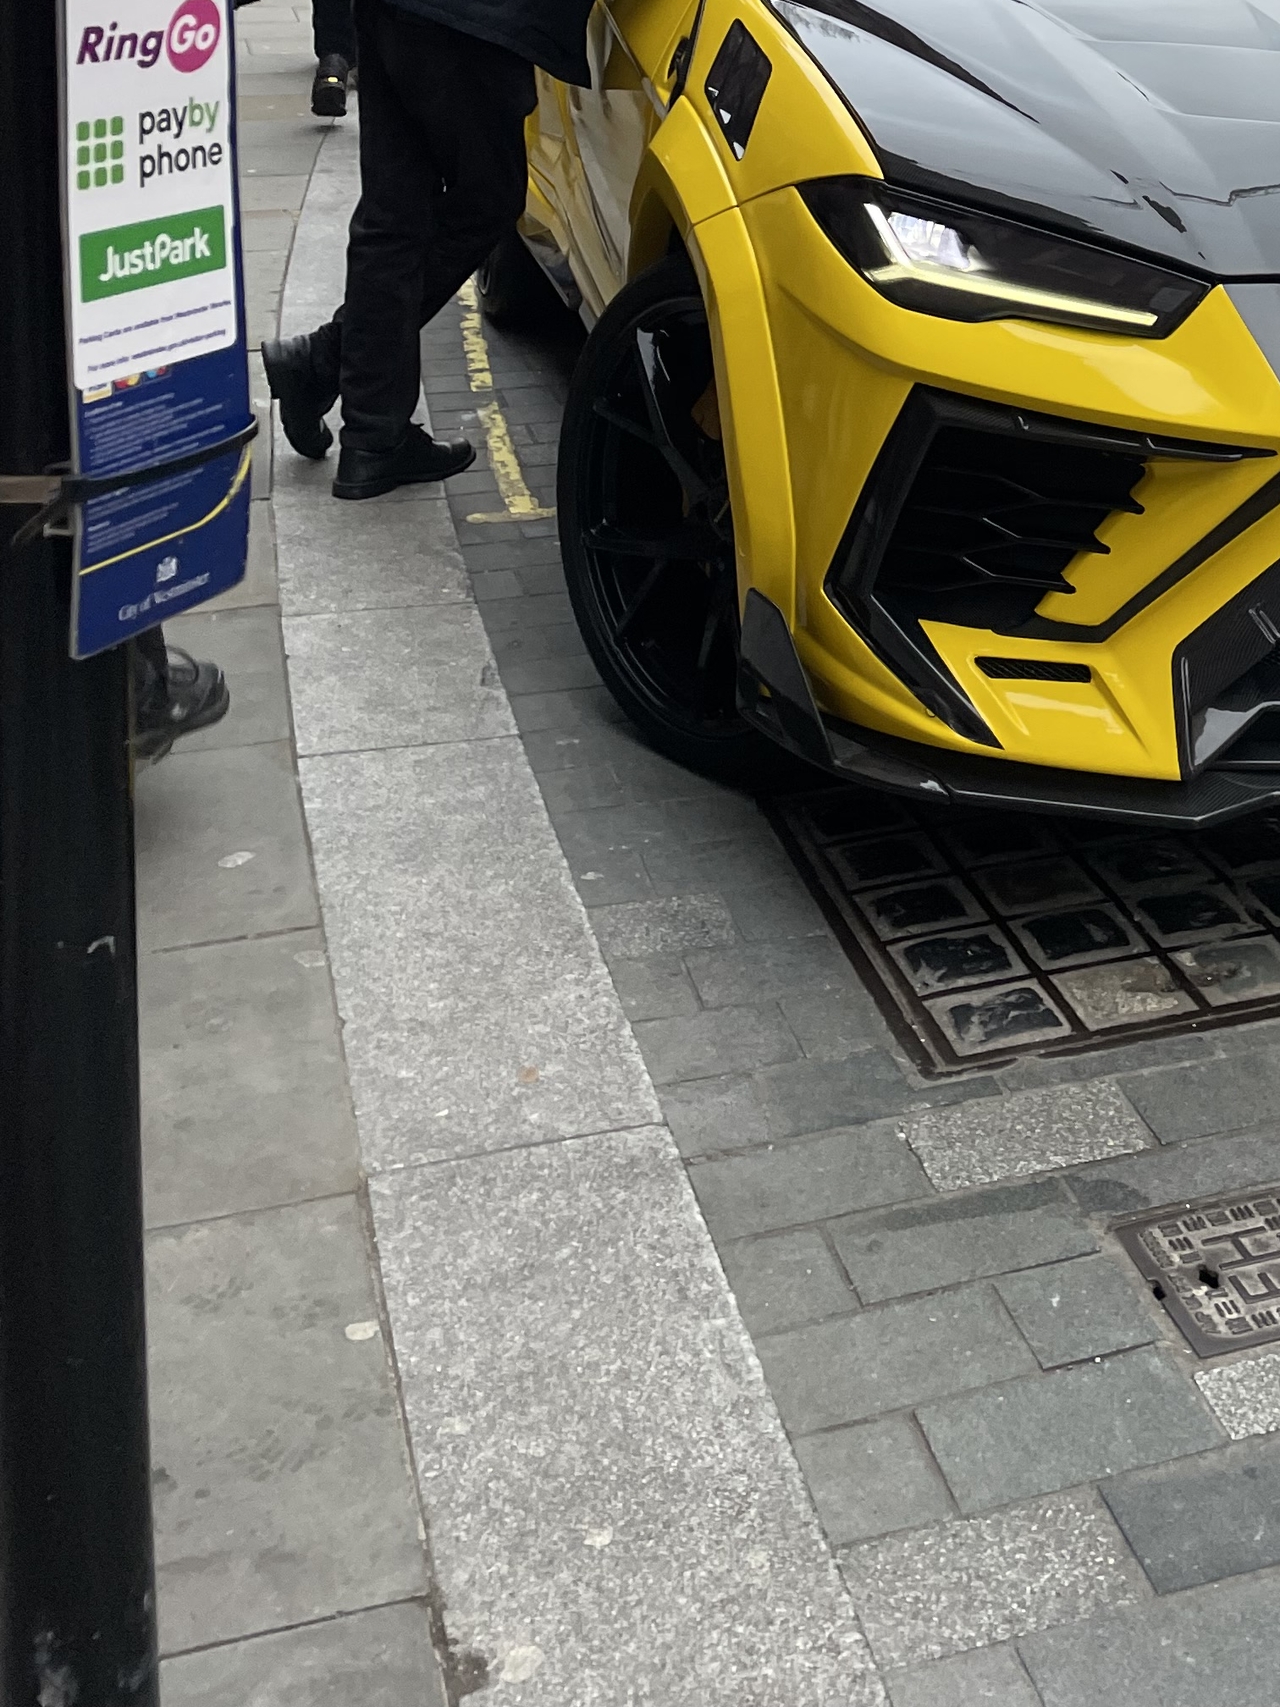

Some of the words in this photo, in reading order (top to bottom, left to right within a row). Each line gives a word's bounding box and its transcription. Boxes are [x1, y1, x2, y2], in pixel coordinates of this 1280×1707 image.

[139, 96, 220, 144] payby
[139, 140, 222, 187] phone
[98, 227, 211, 282] JustPark
